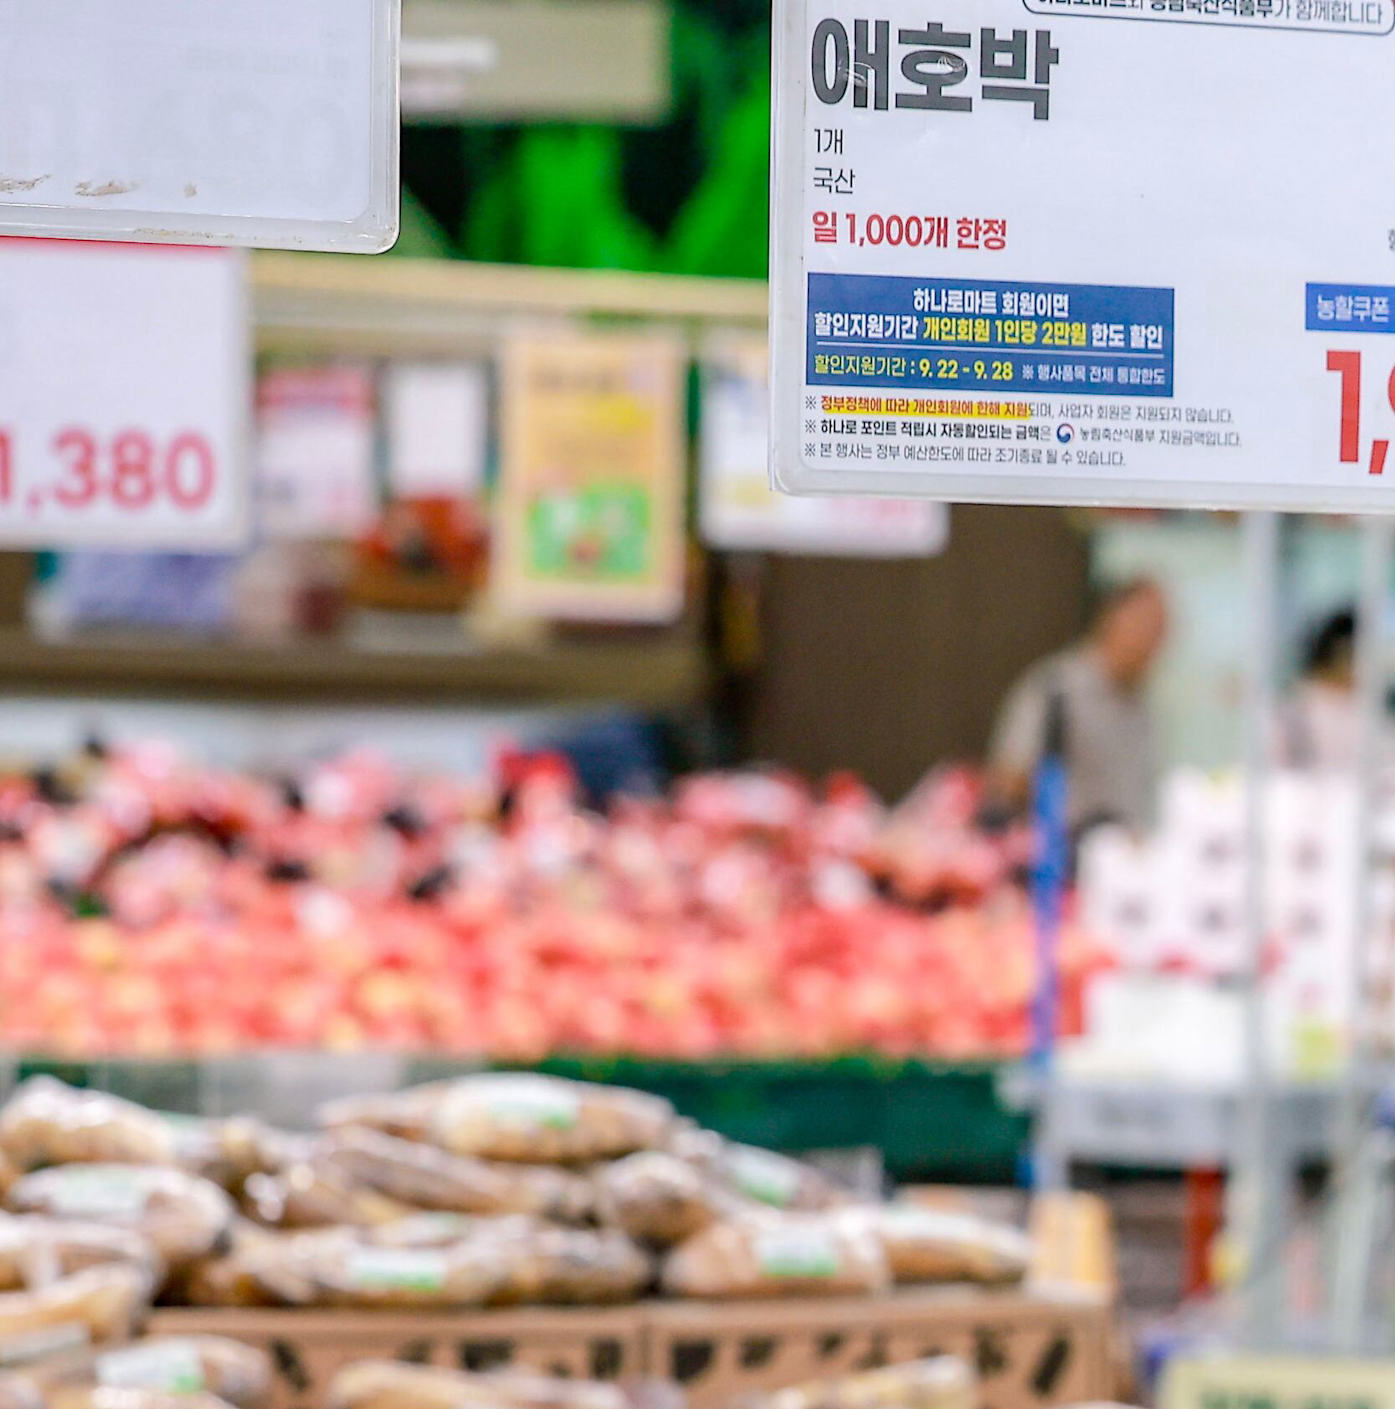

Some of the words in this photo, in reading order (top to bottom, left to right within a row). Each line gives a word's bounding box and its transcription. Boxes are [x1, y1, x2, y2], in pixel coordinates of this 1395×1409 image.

[811, 18, 1060, 121] 애호박
[814, 128, 844, 155] 1개
[812, 167, 856, 194] 국산
[812, 211, 838, 243] 일
[845, 213, 948, 249] 1,000개
[956, 217, 1008, 251] 한정
[913, 287, 998, 314] 하나로마트
[1001, 291, 1070, 319] 회원이면
[814, 311, 919, 339] 할인지원기간
[922, 317, 990, 343] 개인회원
[995, 319, 1039, 346] 1인당
[1041, 321, 1087, 347] 2만원
[1091, 323, 1126, 349] 한도
[1129, 323, 1164, 350] 할인
[814, 354, 907, 377] 할인지원기간
[821, 394, 882, 412] 정부정책에
[885, 397, 910, 413] 따라
[912, 399, 973, 416] 개인회원에
[976, 400, 1001, 416] 한해
[820, 419, 858, 435] 하나로
[860, 420, 898, 436] 포인트
[900, 421, 938, 437] 적립시
[835, 444, 873, 459] 행사는
[967, 447, 992, 463] 따라
